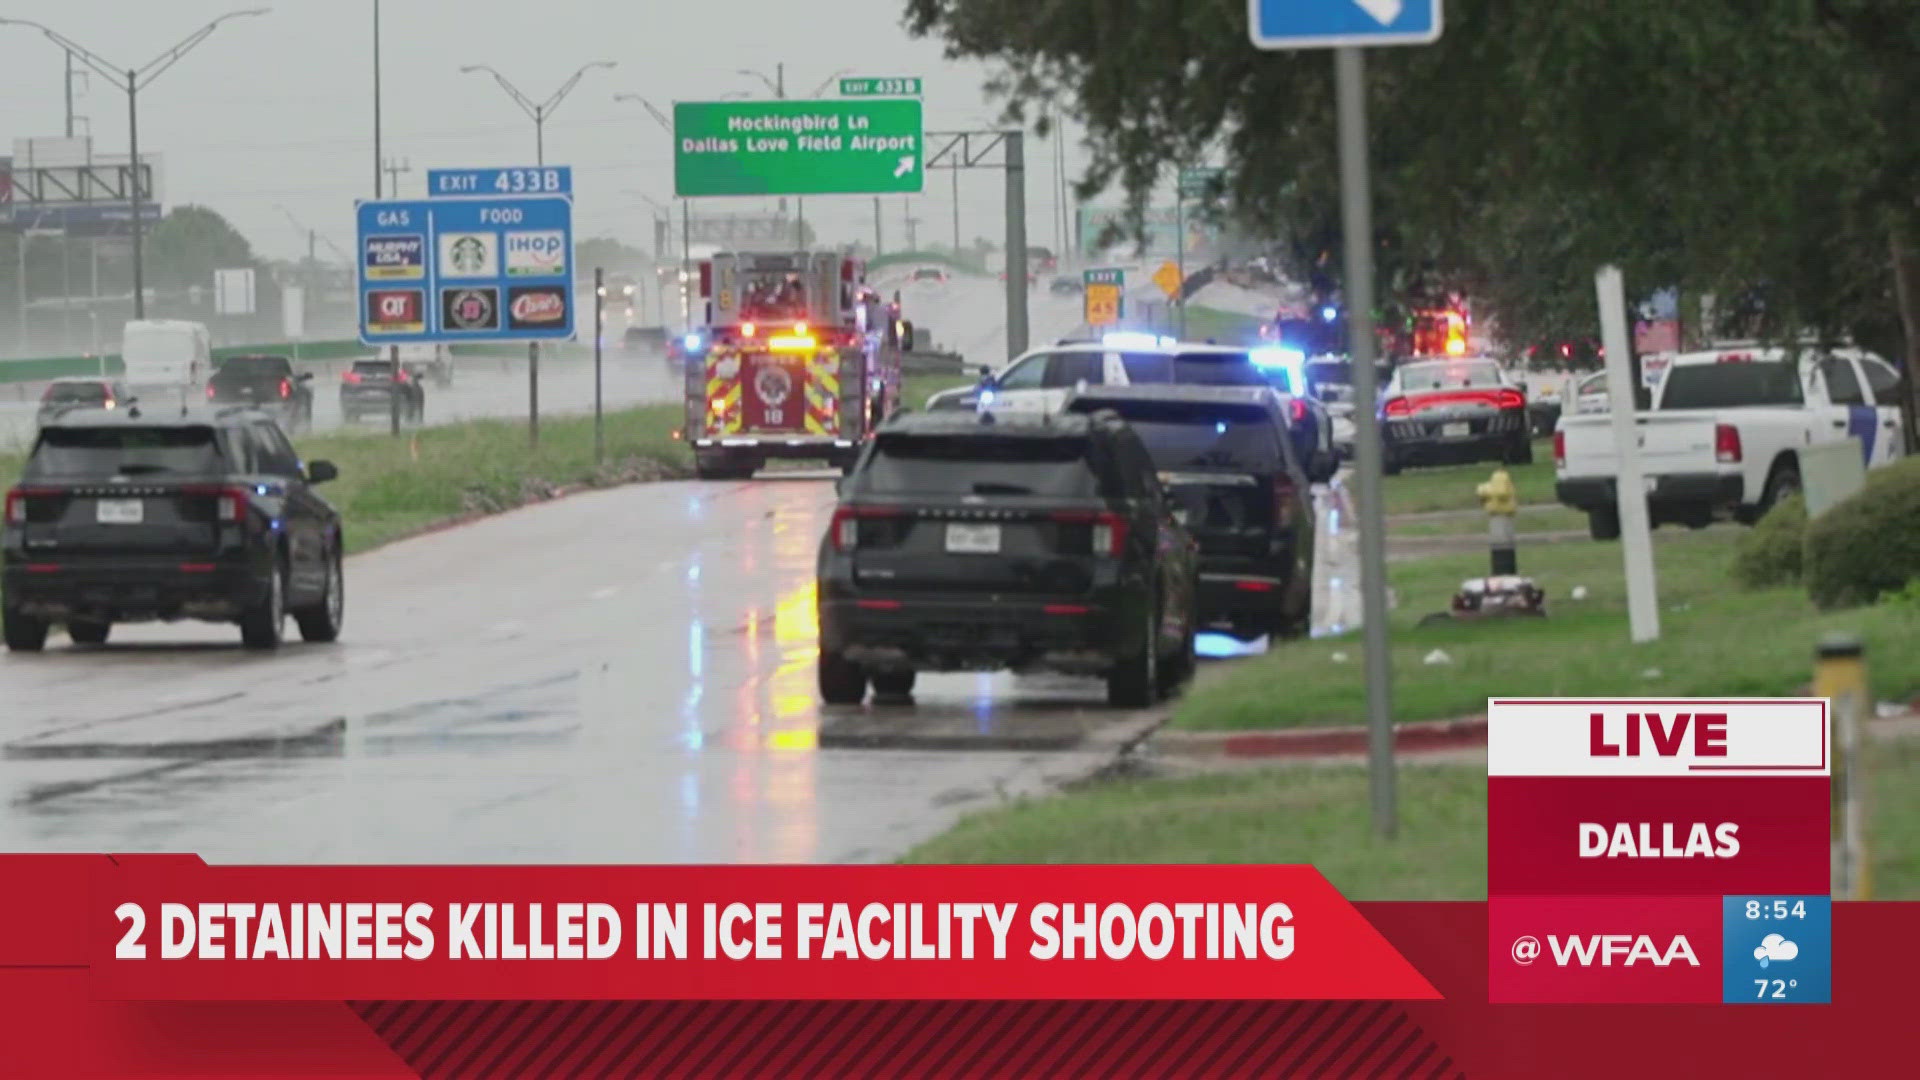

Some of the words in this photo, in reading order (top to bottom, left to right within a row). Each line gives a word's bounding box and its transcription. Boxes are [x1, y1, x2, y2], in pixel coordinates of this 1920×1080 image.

[728, 114, 839, 134] Mockingbird
[848, 115, 869, 129] Ln
[682, 138, 738, 153] Dallas
[746, 137, 789, 152] Love
[797, 136, 842, 151] Field
[850, 135, 916, 153] Airport
[439, 175, 479, 191] EXIT
[494, 169, 560, 192] 433B
[377, 211, 410, 226] GAS
[480, 208, 523, 224] FOOD
[380, 296, 408, 317] QT
[763, 409, 784, 424] 18
